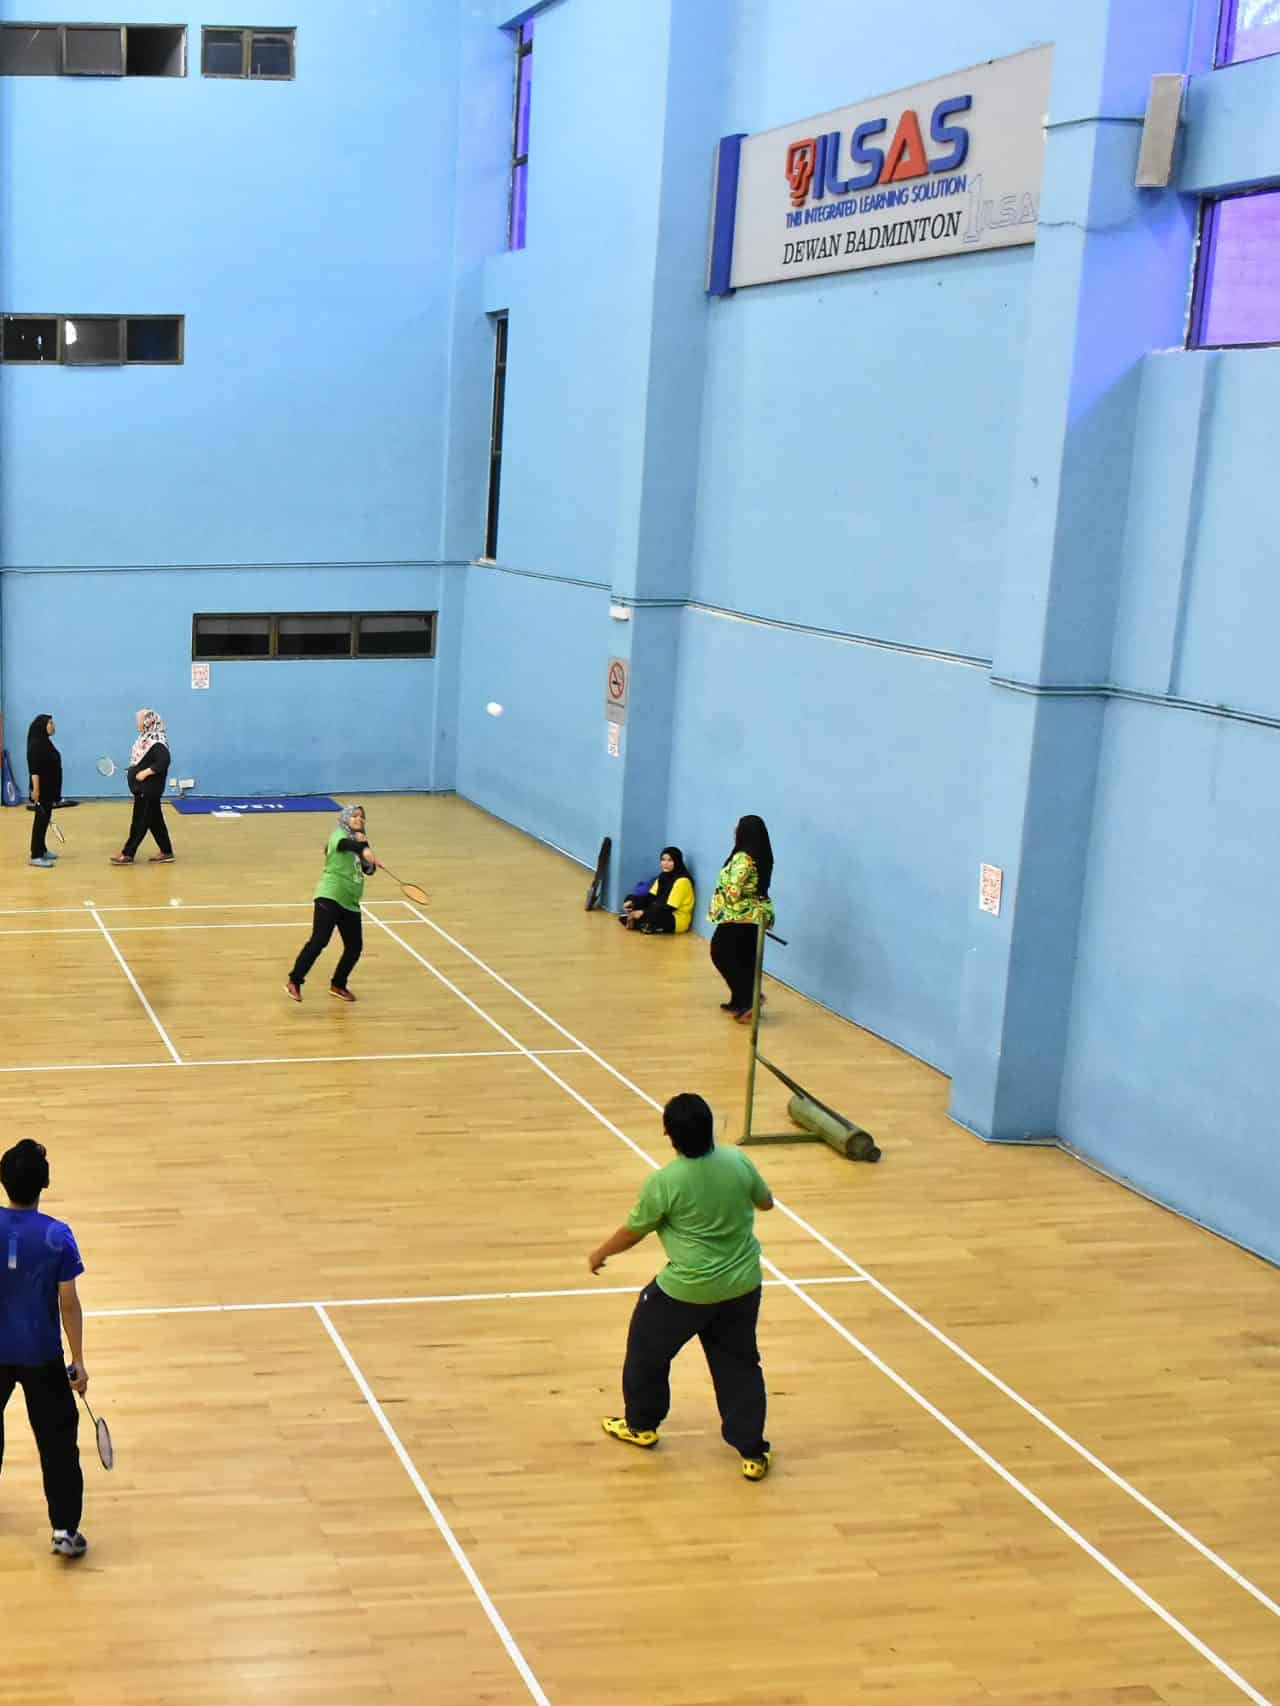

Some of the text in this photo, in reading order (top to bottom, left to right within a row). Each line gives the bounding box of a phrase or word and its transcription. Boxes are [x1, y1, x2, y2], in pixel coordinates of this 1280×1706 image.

[813, 95, 972, 199] ILSAS
[804, 199, 857, 225] INTEGRATED
[859, 188, 909, 214] LEARNING
[911, 174, 967, 202] SOLUTION
[782, 211, 962, 265] DEWAN BADMINTON
